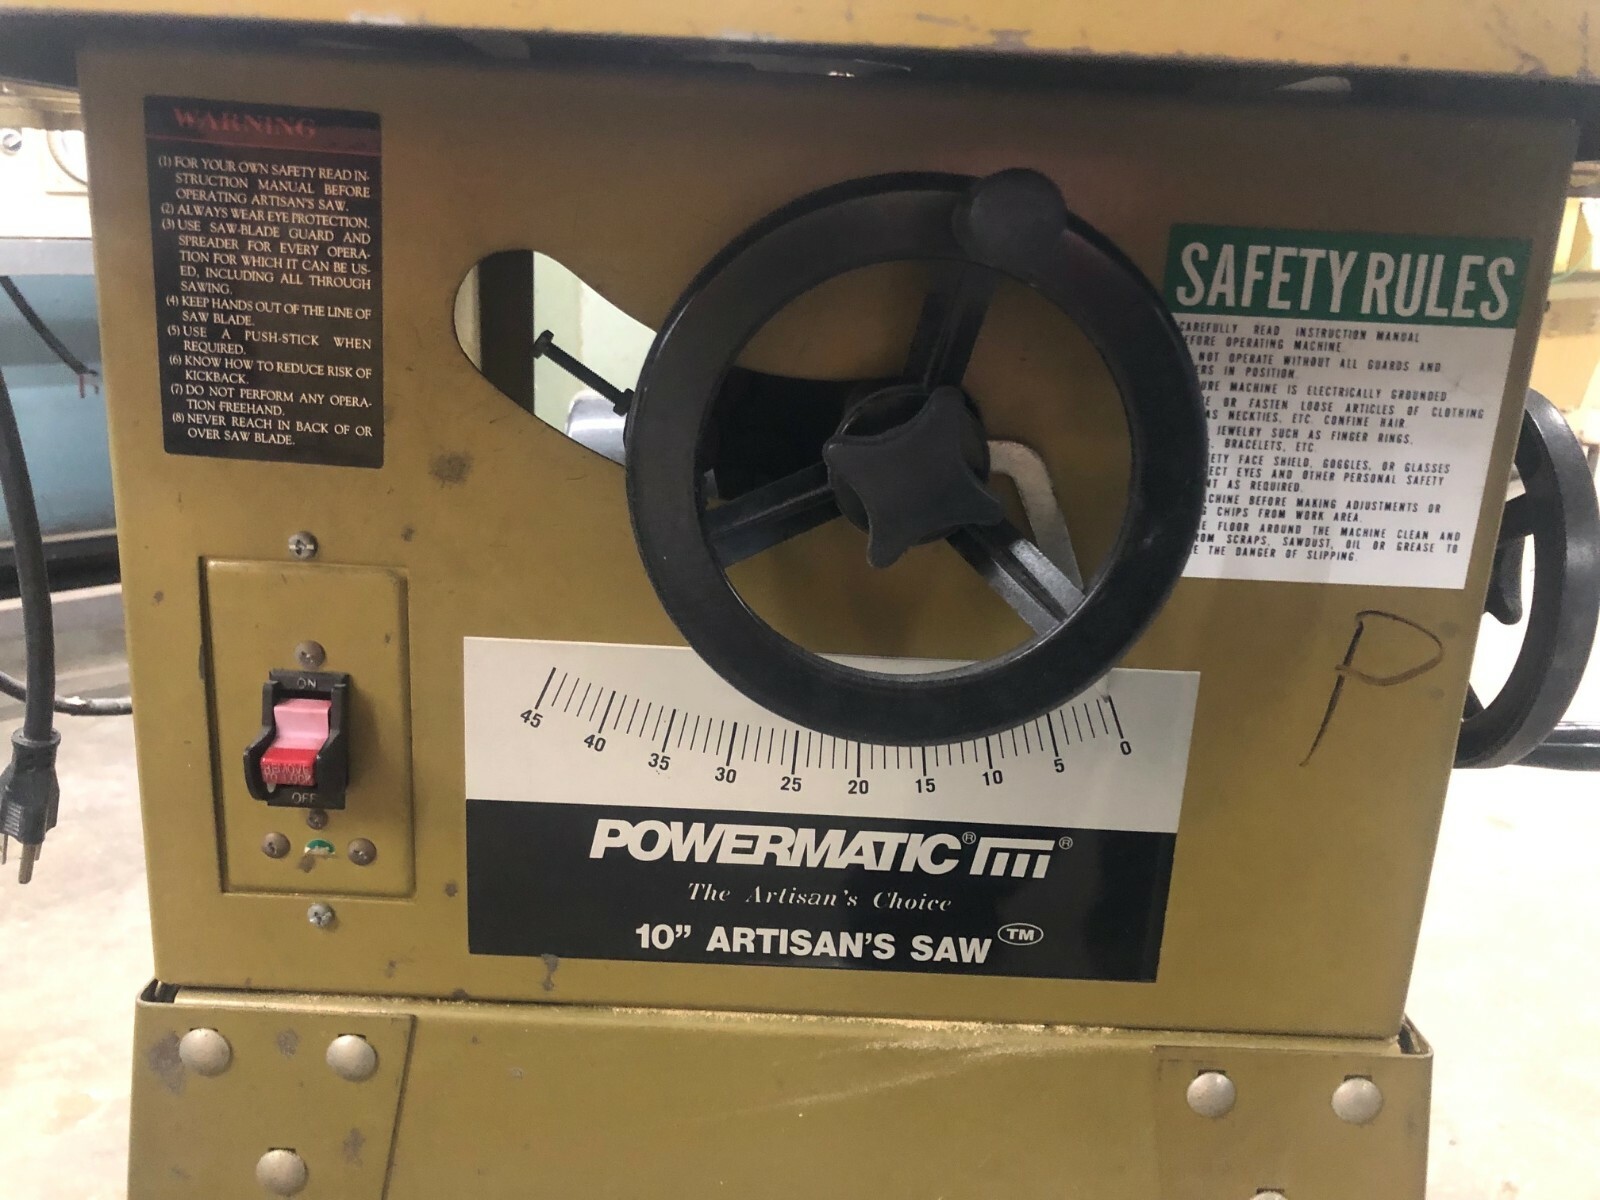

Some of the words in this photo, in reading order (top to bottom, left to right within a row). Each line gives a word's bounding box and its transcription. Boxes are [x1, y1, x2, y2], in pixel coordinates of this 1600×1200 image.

[173, 106, 317, 138] WARNING
[174, 156, 198, 169] FOR
[201, 158, 235, 172] YOUR
[238, 161, 268, 174] OWN
[271, 164, 316, 178] SAFETY
[318, 167, 352, 181] READ
[354, 170, 369, 182] IN-
[175, 172, 248, 188] STRUCTION
[258, 178, 314, 194] MANUAL
[324, 184, 370, 198] BEFORE
[176, 188, 246, 204] OPERATING
[251, 193, 314, 209] ARTISAN'S
[318, 198, 348, 212] SAW.
[177, 204, 228, 218] ALWAYS
[230, 208, 264, 221] WEAR
[267, 210, 289, 223] EYE
[291, 212, 369, 229] PROTECTION.
[177, 219, 200, 232] USE
[210, 222, 280, 238] SAW-BLADE
[288, 228, 333, 242] GUARD
[343, 232, 370, 245] AND
[178, 235, 239, 250] SPREADER
[247, 240, 271, 253] FOR
[280, 242, 318, 256] EVERY
[327, 246, 370, 260] OPERA-
[179, 250, 209, 264] TION
[213, 253, 236, 266] FOR
[240, 255, 282, 269] WHICH
[286, 258, 298, 270] IT
[302, 260, 328, 273] CAN
[333, 262, 347, 274] BE
[351, 264, 370, 276] US-
[179, 265, 199, 277] ED,
[205, 267, 274, 283] INCLUDING
[280, 273, 302, 285] ALL
[308, 275, 370, 290] THROUGH
[180, 280, 232, 295] SAWING.
[1175, 242, 1358, 313] SAFETY
[1361, 252, 1515, 321] RULES
[182, 295, 209, 308] KEEP
[212, 297, 253, 312] HANDS
[255, 301, 281, 314] OUT
[283, 303, 299, 315] OF
[301, 304, 325, 317] THE
[327, 306, 353, 319] LINE
[355, 308, 371, 320] OF
[182, 310, 208, 323] SAW
[213, 313, 254, 327] BLADE.
[182, 325, 206, 338] USE
[221, 328, 230, 339] A
[244, 330, 318, 346] PUSH-STICK
[333, 336, 370, 350] WHEN
[1225, 336, 1283, 349] OPERATING
[1253, 324, 1280, 336] READ
[1295, 326, 1366, 340] INSTRUCTION
[183, 340, 246, 356] REQUIRED.
[184, 354, 221, 368] KNOW
[224, 357, 253, 370] HOW
[256, 360, 273, 372] TO
[276, 361, 324, 376] REDUCE
[327, 365, 352, 378] RISK
[355, 367, 371, 380] OF
[1198, 351, 1219, 362] NOT
[1228, 352, 1273, 365] OPERATE
[1283, 355, 1330, 367] WITHOUT
[1339, 358, 1356, 368] ALL
[1367, 359, 1409, 371] GUARDS
[1419, 361, 1440, 372] AND
[1224, 365, 1235, 376] IN
[185, 369, 248, 385] KICKBACK.
[186, 384, 204, 396] DO
[209, 386, 234, 399] NOT
[240, 388, 293, 403] PERFORM
[299, 393, 324, 406] ANY
[330, 395, 372, 409] OPERA-
[1229, 381, 1277, 394] MACHINE
[1287, 384, 1297, 395] IS
[1307, 385, 1381, 399] ELECTRICALLY
[1390, 389, 1446, 402] GROUNDED
[186, 398, 215, 412] TION
[218, 401, 284, 417] FREEHAND.
[1223, 397, 1236, 408] OR
[1248, 398, 1288, 410] FASTEN
[1300, 400, 1332, 412] LOOSE
[1345, 403, 1394, 415] ARTICLES
[1406, 406, 1419, 416] OF
[1431, 407, 1484, 419] CLOTHING
[187, 413, 226, 427] NEVER
[231, 416, 271, 430] REACH
[278, 420, 290, 431] IN
[296, 421, 328, 434] BACK
[334, 424, 349, 436] OF
[355, 425, 372, 438] OR
[1324, 414, 1368, 427] CONFINE
[188, 427, 220, 440] OVER
[224, 430, 250, 442] SAW
[254, 432, 294, 446] BLADE.
[1216, 425, 1261, 437] JEWELRY
[1271, 428, 1298, 439] SUCH
[1307, 429, 1321, 440] AS
[1331, 430, 1368, 442] FINGER
[1238, 454, 1263, 465] FACE
[1382, 461, 1394, 472] OR
[1404, 462, 1450, 474] GLASSES
[1226, 479, 1240, 490] AS
[1236, 466, 1261, 478] EYES
[1271, 468, 1292, 479] AND
[1302, 470, 1335, 481] OTHER
[1343, 472, 1395, 484] PERSONAL
[1406, 475, 1444, 487] SAFETY
[1216, 506, 1248, 517] CHIPS
[1258, 508, 1285, 519] FROM
[1296, 510, 1323, 521] WORK
[1248, 494, 1286, 506] BEFORE
[1296, 497, 1336, 509] MAKING
[1346, 499, 1418, 513] ADJUSTMENTS
[1428, 503, 1440, 514] OR
[1218, 520, 1249, 532] FLOOR
[1259, 522, 1301, 534] AROUND
[1313, 525, 1329, 536] THE
[1340, 526, 1385, 538] MACHINE
[1396, 529, 1428, 541] CLEAN
[1440, 531, 1460, 542] AND
[1208, 544, 1225, 555] THE
[1235, 546, 1276, 558] DANGER
[1285, 548, 1297, 559] OF
[1346, 539, 1360, 550] OIL
[1372, 540, 1385, 551] OR
[1396, 541, 1434, 553] GREASE
[1447, 544, 1457, 554] TO
[297, 677, 317, 690] ON
[1299, 610, 1444, 767] P
[520, 709, 543, 728] 45
[584, 736, 607, 752] 40
[648, 753, 671, 771] 35
[714, 767, 737, 784] 30
[780, 776, 802, 792] 25
[847, 779, 869, 795] 20
[915, 778, 936, 793] 15
[982, 770, 1003, 786] 10
[1054, 758, 1065, 774] 5
[1120, 741, 1132, 756] 0
[291, 791, 318, 804] OFF
[688, 882, 731, 902] The
[746, 885, 858, 907] Artisan's
[873, 891, 951, 911] Choice
[706, 926, 896, 960] ARTISAN'S
[910, 935, 992, 964] SAW
